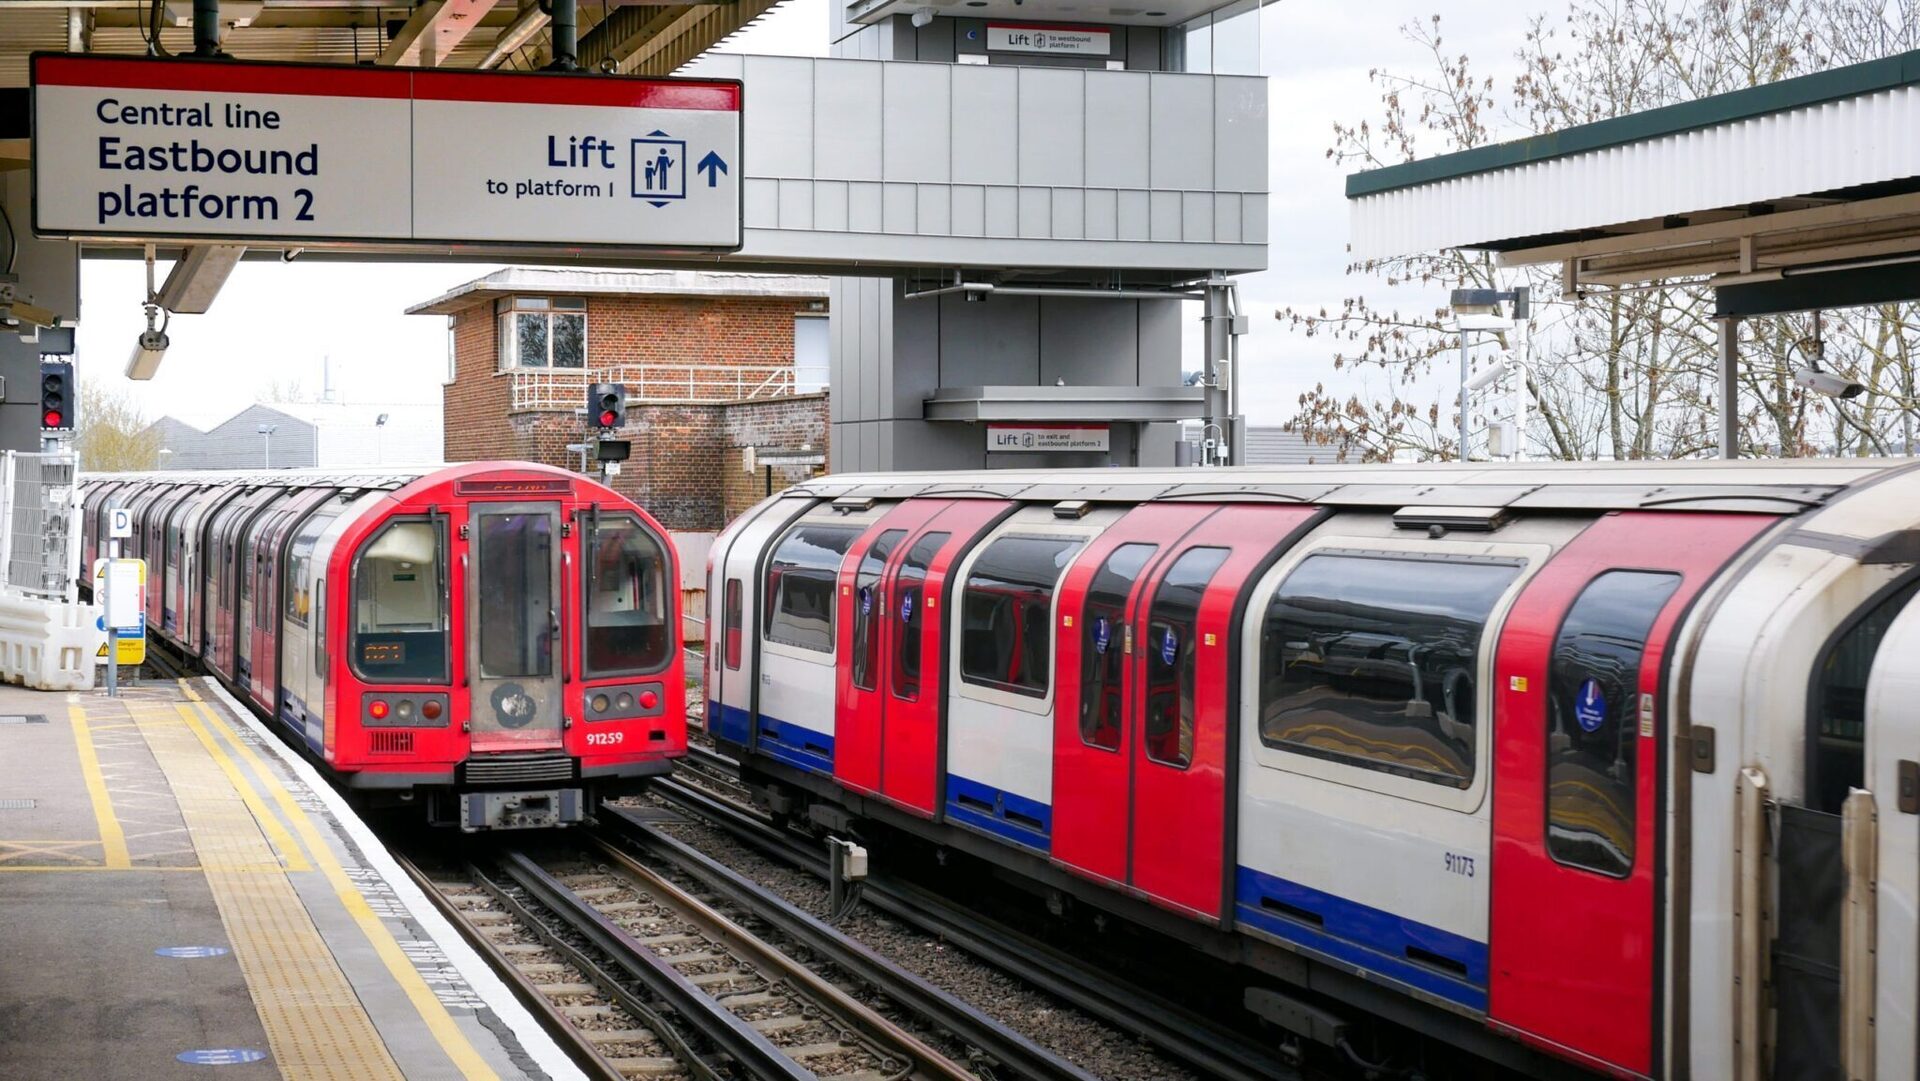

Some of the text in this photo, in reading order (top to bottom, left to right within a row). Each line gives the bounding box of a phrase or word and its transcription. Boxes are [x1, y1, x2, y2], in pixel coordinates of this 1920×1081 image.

[1008, 34, 1030, 45] Lift
[96, 98, 280, 129] Central line
[98, 136, 318, 176] Eastbound
[548, 135, 615, 169] Lift
[486, 179, 508, 194] to
[516, 179, 600, 199] platform
[98, 184, 315, 224] platform 2
[997, 434, 1018, 445] Lift
[1070, 440, 1095, 448] platform
[116, 511, 127, 529] D
[586, 731, 624, 745] 91259
[1444, 852, 1475, 877] 91173
